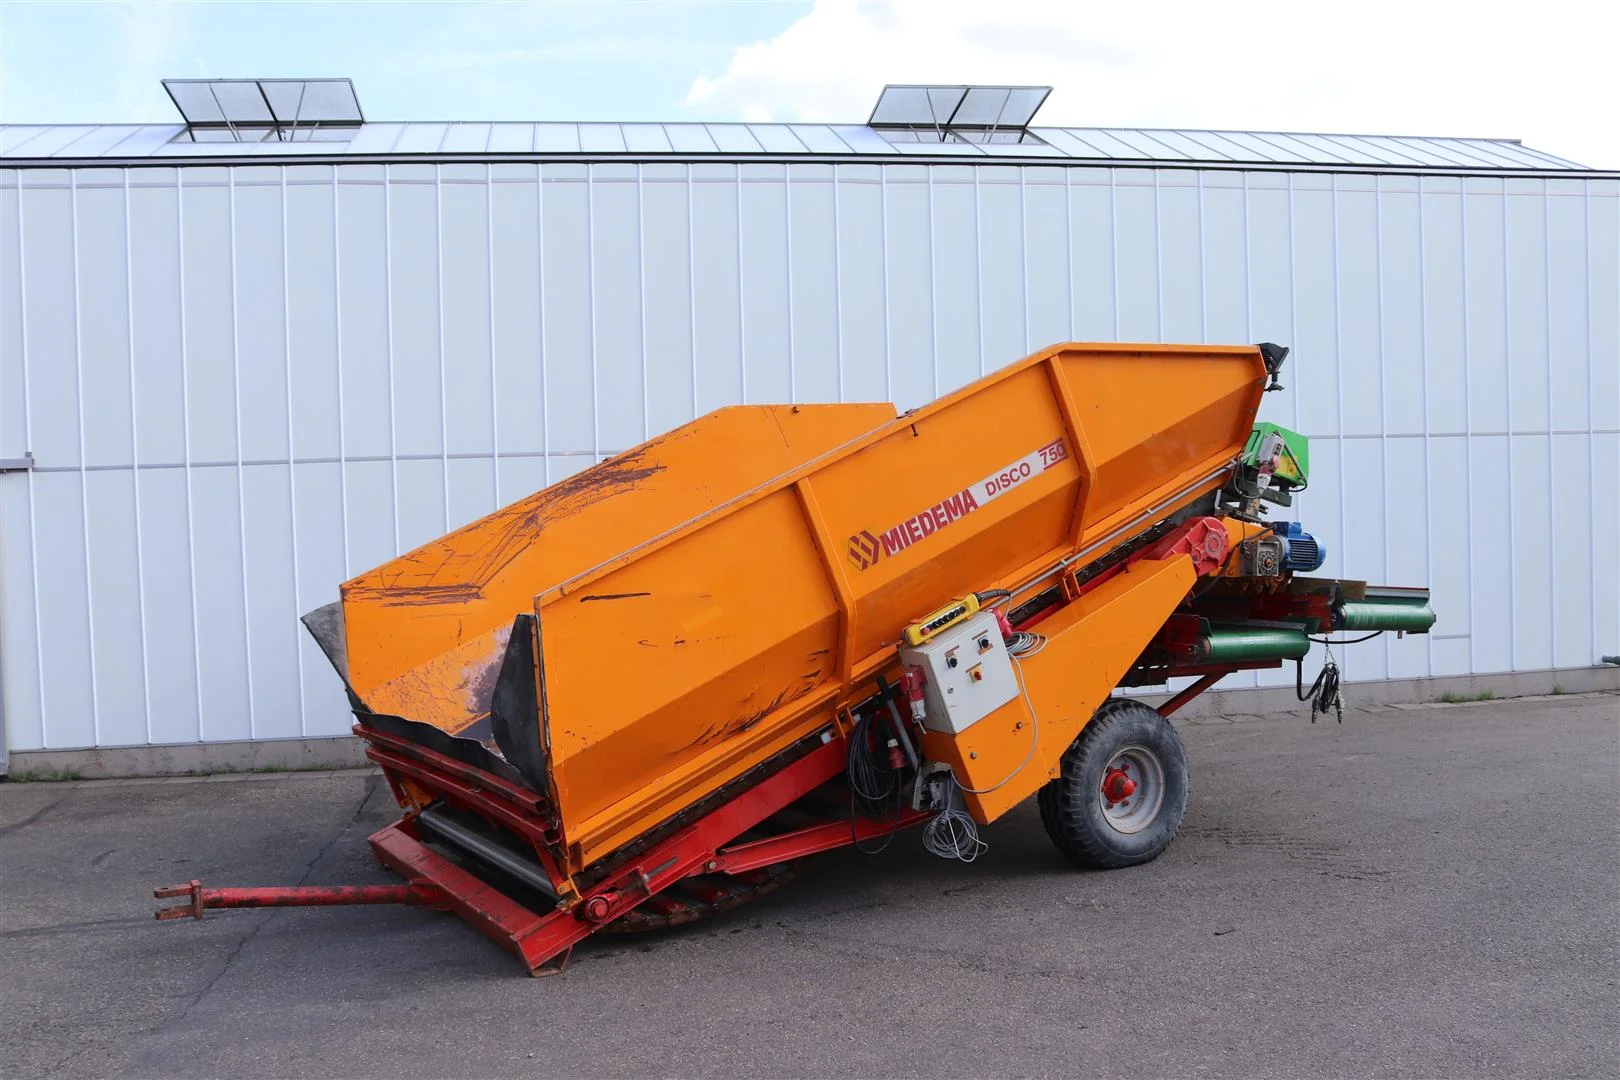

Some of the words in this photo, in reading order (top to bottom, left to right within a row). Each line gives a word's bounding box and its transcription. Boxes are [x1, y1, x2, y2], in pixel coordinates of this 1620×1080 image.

[879, 488, 979, 558] MIEDEMA
[985, 462, 1031, 496] DISCO
[1039, 443, 1065, 466] 750
